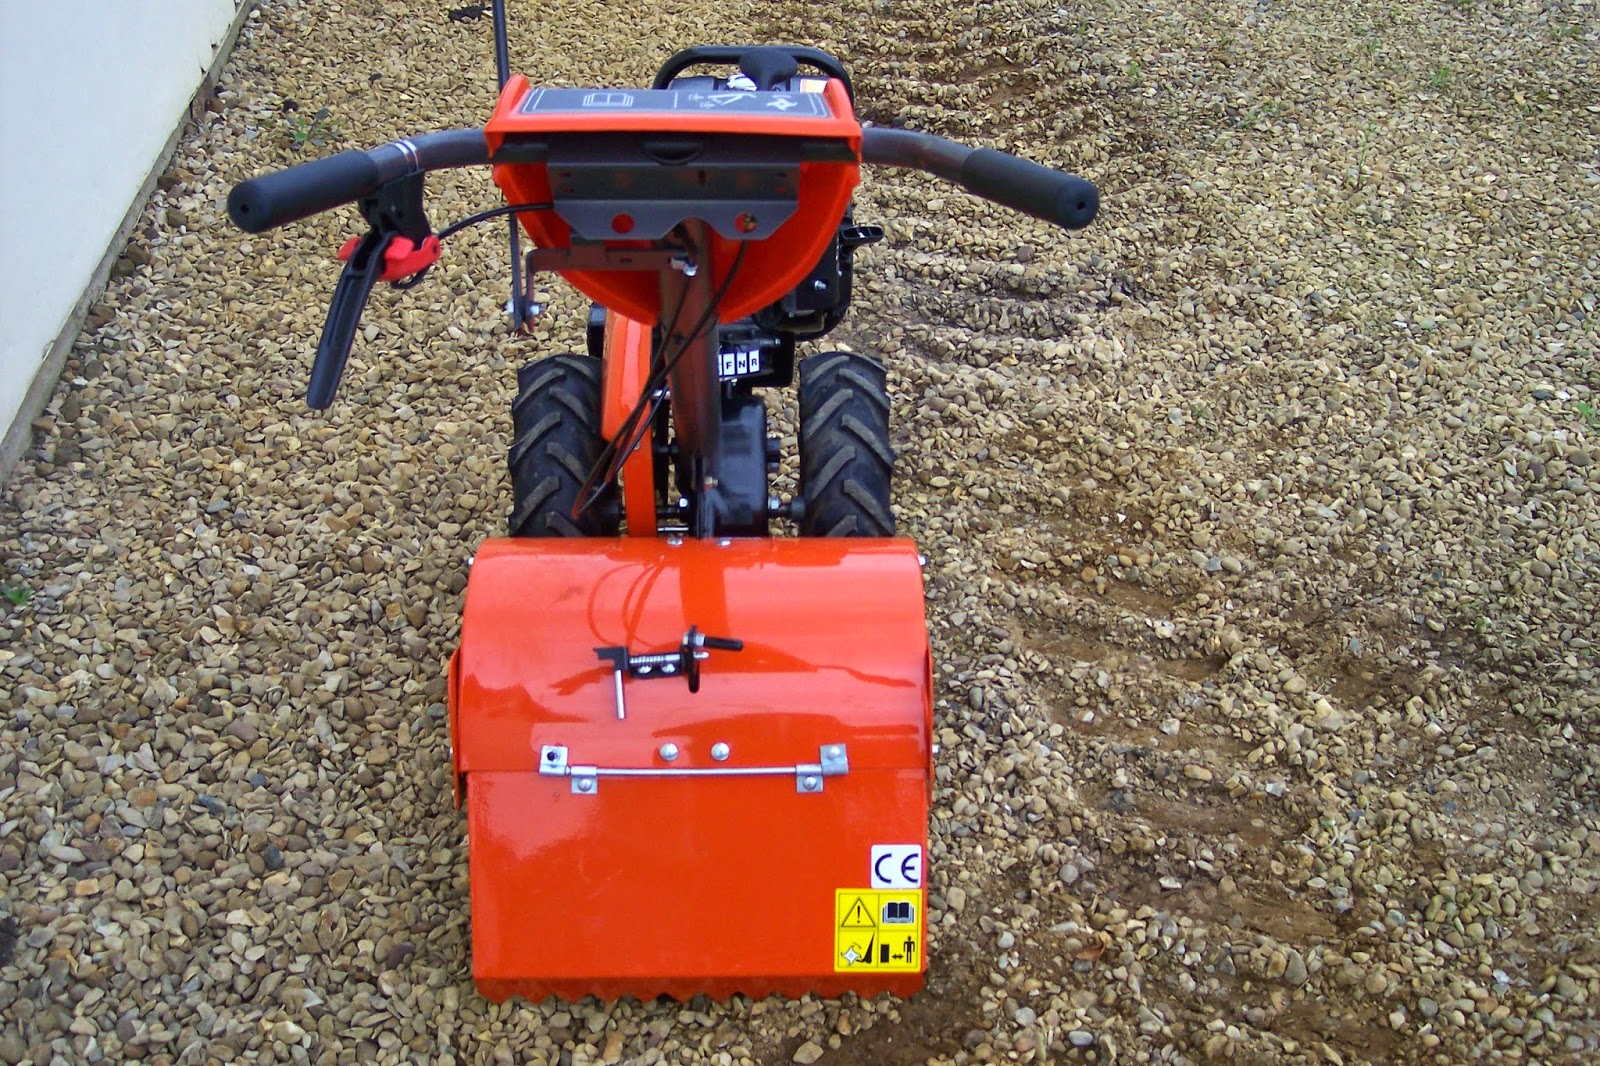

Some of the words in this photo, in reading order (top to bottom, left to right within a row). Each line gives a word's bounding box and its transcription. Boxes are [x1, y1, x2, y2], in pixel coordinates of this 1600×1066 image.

[726, 361, 732, 370] F
[738, 360, 746, 368] N
[751, 358, 758, 366] R
[874, 853, 919, 884] CE
